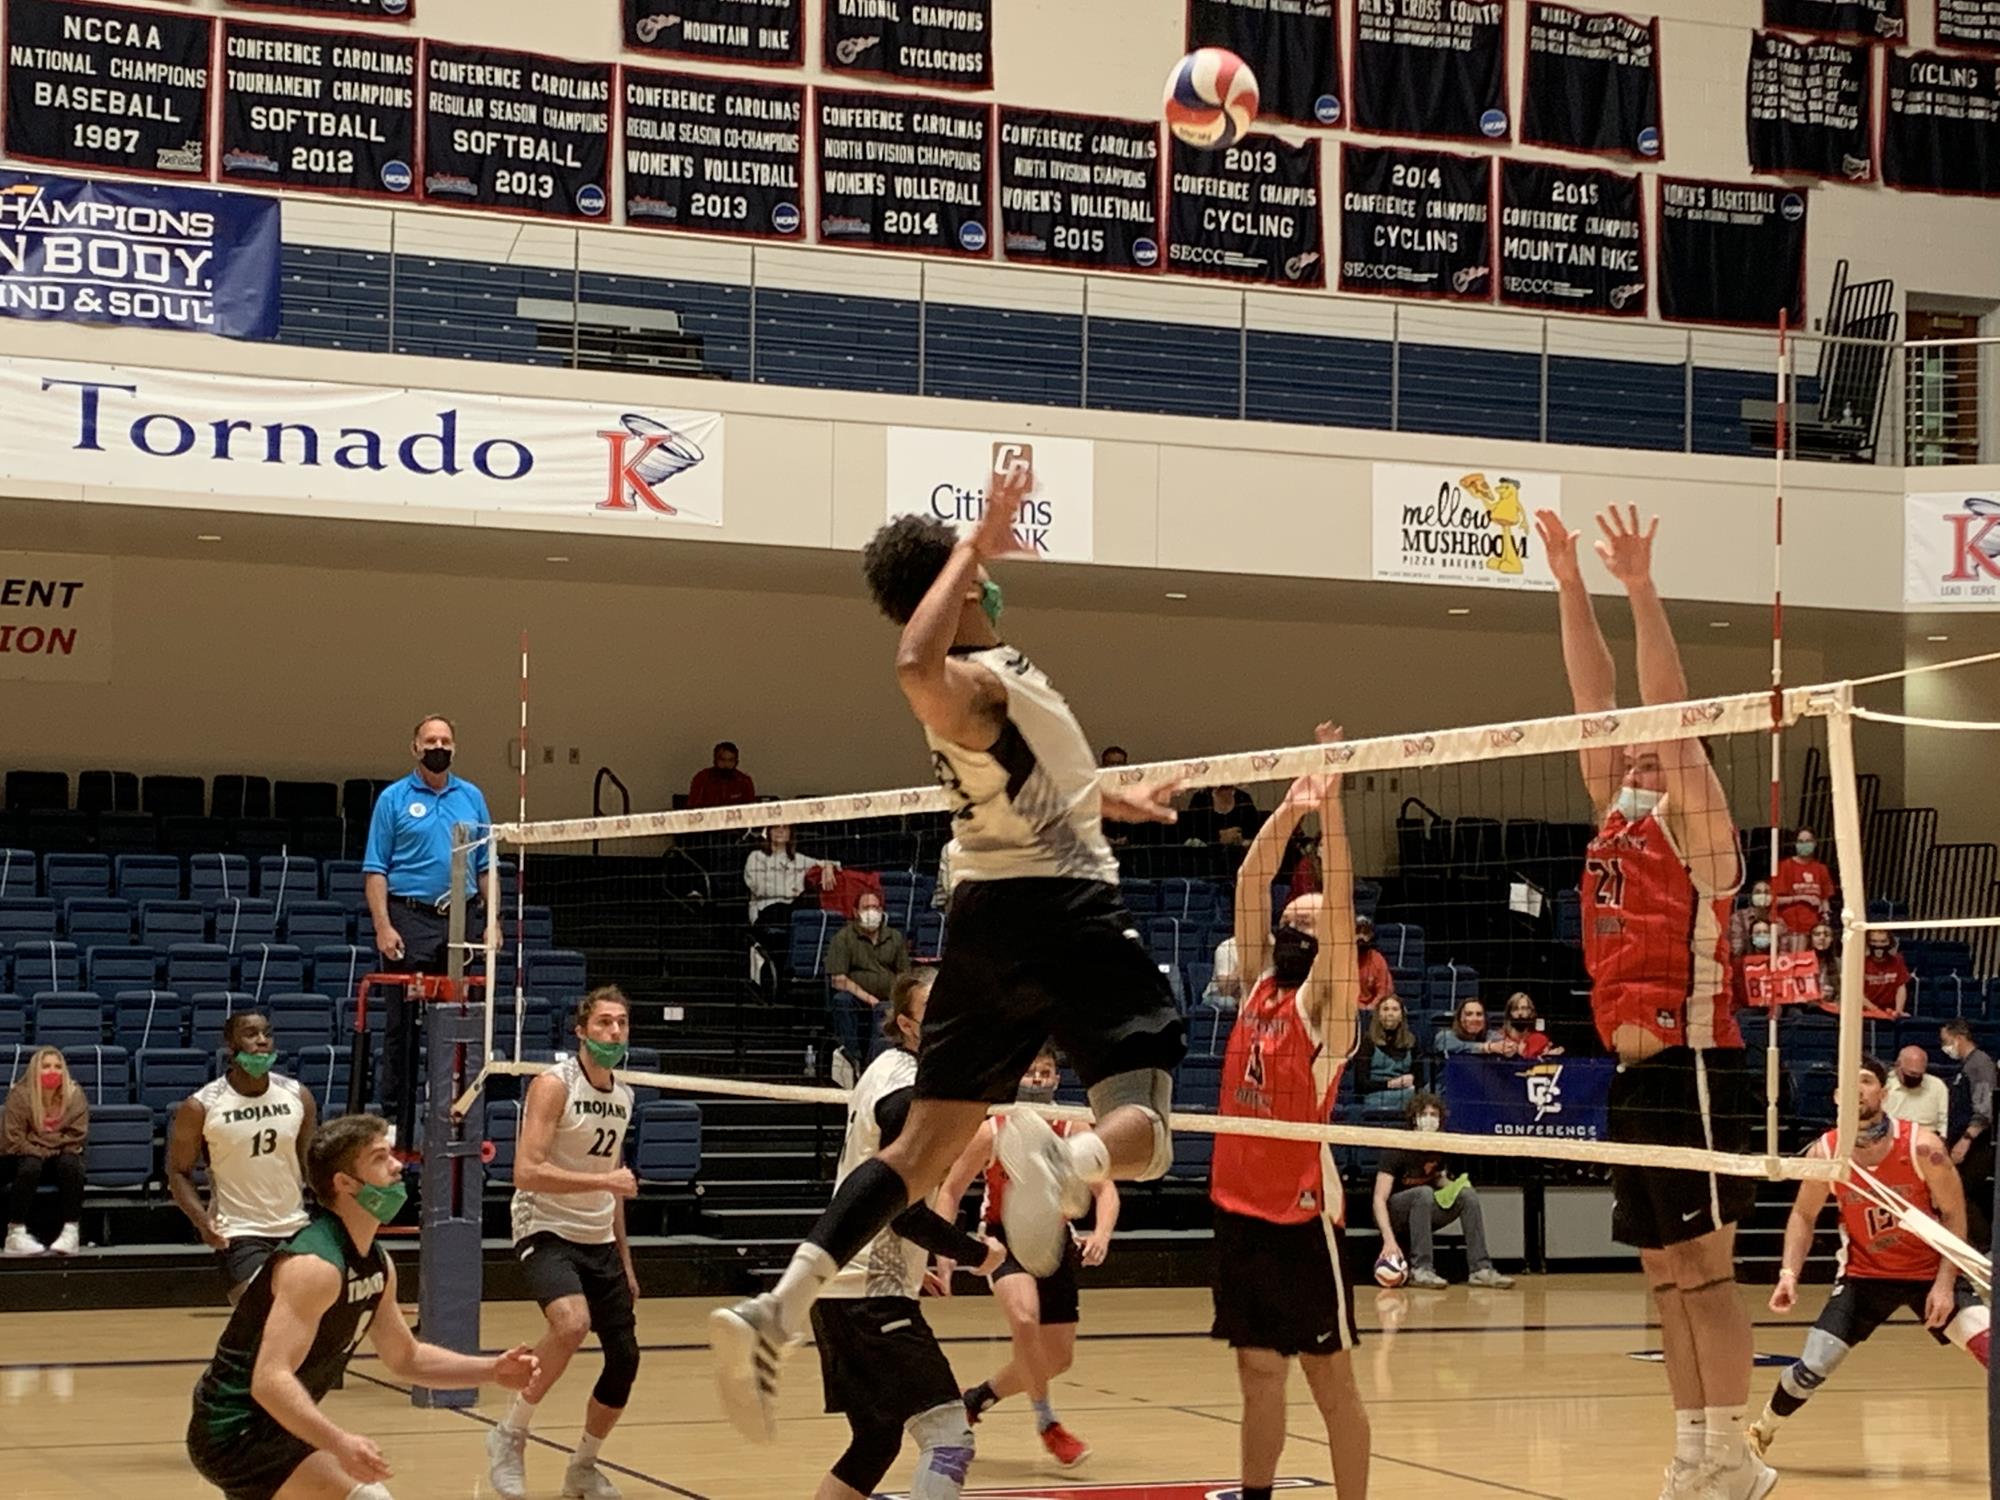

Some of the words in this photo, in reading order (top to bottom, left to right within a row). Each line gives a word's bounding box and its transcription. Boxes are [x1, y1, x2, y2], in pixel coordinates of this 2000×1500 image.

[912, 5, 983, 32] CHAMPIONS
[1402, 0, 1442, 21] CROSS
[64, 15, 162, 50] NCCAA
[683, 20, 749, 46] MOUNTAIN
[759, 28, 790, 50] BIKE
[11, 45, 96, 76] NATIONAL
[110, 58, 206, 89] CHAMPIONS
[227, 36, 321, 66] CONFERENCE
[333, 47, 413, 76] CAROLINAS
[900, 46, 983, 73] CYCLOCROSS
[227, 70, 321, 99] TOURNAMENT
[333, 81, 412, 109] CHAMPIONS
[430, 59, 521, 90] CONFERENCE
[531, 71, 608, 101] CAROLINAS
[1910, 62, 1978, 89] CYCLING
[34, 82, 180, 123] BASEBALL
[429, 91, 484, 119] REGULAR
[489, 99, 537, 125] SEASON
[543, 107, 608, 133] CHAMPIONS
[627, 84, 715, 114] CONFERENCE
[725, 97, 800, 122] CAROLINAS
[250, 106, 385, 142] SOFTBALL
[627, 117, 675, 142] REGULAR
[679, 122, 721, 147] SEASON
[724, 128, 799, 154] CO-CHAMPIONS
[823, 105, 904, 133] CONFERENCE
[913, 114, 983, 140] CAROLINAS
[1001, 123, 1084, 152] CONFERENCE
[73, 124, 140, 153] 1987
[453, 129, 581, 168] SOFTBALL
[291, 147, 354, 174] 2012
[627, 151, 694, 179] WOMEN'S
[703, 157, 798, 189] VOLLEYBALL
[824, 137, 863, 161] NORTH
[866, 143, 915, 166] DIVISION
[917, 148, 981, 172] CHAMPIONS
[1225, 148, 1277, 174] 2013
[495, 169, 554, 198] 2013
[824, 170, 886, 197] WOMEN'S
[894, 175, 981, 207] VOLLEYBALL
[1014, 157, 1047, 179] NORTH
[1050, 160, 1091, 184] DIVISION
[1093, 165, 1147, 189] CHAMPIONS
[1392, 164, 1441, 190] 2014
[690, 193, 747, 220] 2013
[1002, 186, 1062, 213] WOMEN'S
[1070, 193, 1155, 223] VOLLEYBALL
[1260, 183, 1316, 207] CHAMPINS
[1552, 180, 1599, 206] 2015
[1711, 187, 1776, 214] BASKETBALL
[883, 210, 939, 236] 2014
[1053, 226, 1104, 251] 2015
[1203, 208, 1294, 239] CYCLING
[1502, 207, 1578, 234] CONFERENCE
[1585, 216, 1639, 240] CHAMPIOS
[1374, 225, 1458, 254] CYCLING
[1503, 236, 1596, 267] MOUNTAIN
[1601, 247, 1639, 272] BIKE
[43, 236, 213, 290] BODY,
[74, 287, 104, 313] &
[109, 291, 214, 324] SOUL
[42, 377, 534, 481] Tornado
[931, 483, 1052, 526] Citins
[1402, 481, 1492, 530] mellow
[1402, 528, 1529, 558] MUSHROOM
[1402, 556, 1435, 566] PIZZA
[1442, 558, 1484, 570] BAKERS
[1586, 858, 1625, 909] 21
[222, 1103, 291, 1124] TROJANS
[574, 1100, 627, 1120] TROJANS
[250, 1128, 278, 1158] 13
[587, 1128, 617, 1157] 22
[1494, 1123, 1597, 1137] CONFERENCE
